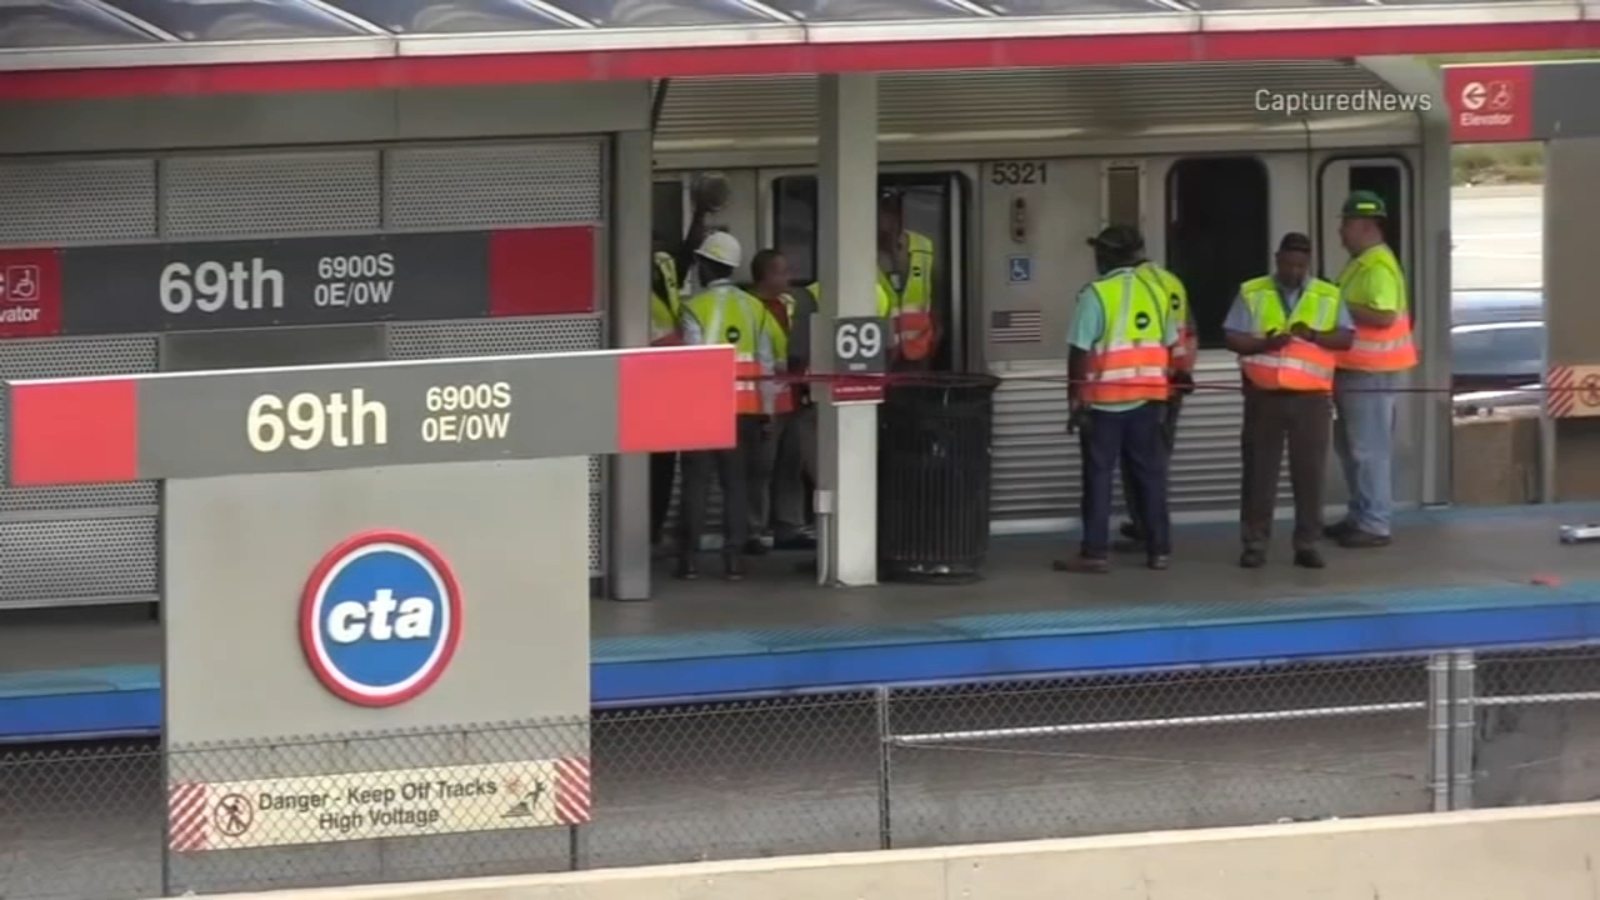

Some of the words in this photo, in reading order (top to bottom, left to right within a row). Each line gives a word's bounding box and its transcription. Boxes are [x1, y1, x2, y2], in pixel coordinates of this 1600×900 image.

[1460, 112, 1514, 127] Elevator
[992, 162, 1047, 185] 5321
[318, 253, 395, 279] 6900S
[159, 258, 284, 313] 69th
[314, 280, 394, 307] 0E/0W
[836, 322, 881, 359] 69
[425, 382, 512, 411] 6900S
[247, 389, 388, 452] 69th
[421, 413, 511, 443] 0E/0W
[327, 588, 434, 644] cta
[258, 792, 330, 812] Danger
[348, 788, 396, 806] Keep
[401, 782, 432, 800] Off
[437, 779, 498, 799] Tracks
[319, 812, 363, 833] High
[369, 808, 440, 827] Voltage
